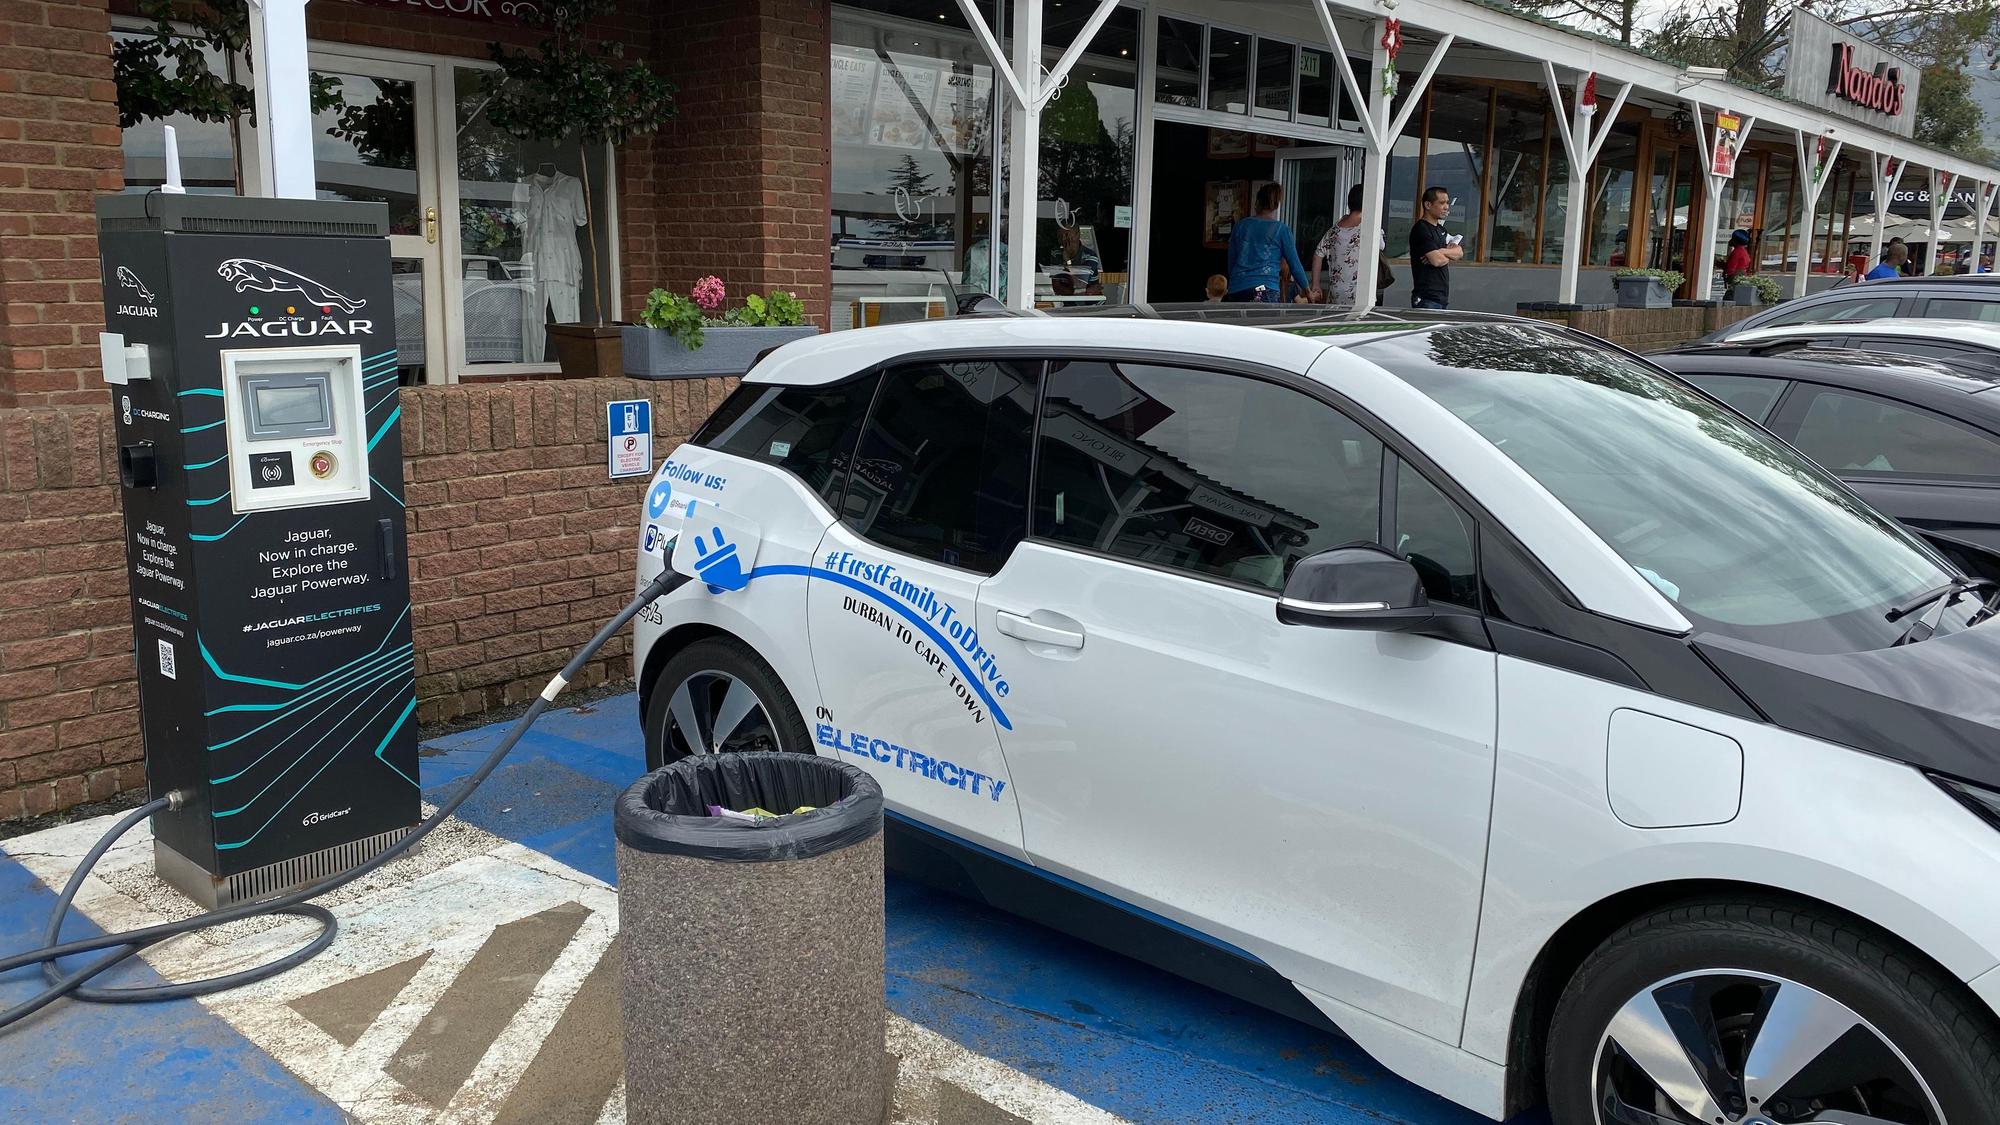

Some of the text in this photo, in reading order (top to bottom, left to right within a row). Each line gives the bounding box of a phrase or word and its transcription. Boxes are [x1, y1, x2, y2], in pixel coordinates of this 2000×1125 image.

[1835, 41, 1905, 116] Nando's
[1870, 191, 1914, 202] GG
[1918, 190, 1930, 202] &
[116, 304, 158, 318] JAGUAR
[204, 319, 374, 339] JAGUAR
[661, 460, 726, 491] Follow us:
[145, 520, 166, 537] Jaguar,
[284, 529, 332, 543] Jaguar,
[137, 533, 178, 555] Now in charge.
[259, 542, 358, 563] Now in charge.
[142, 550, 174, 570] Explore the
[272, 559, 348, 579] Explore the
[135, 563, 154, 579] Jaguar
[250, 573, 370, 599] Jaguar Powerway.
[242, 603, 382, 633] #JAGUARELECTRIFIES
[824, 551, 1011, 698] #FirstFamilyToDrive
[266, 624, 362, 648] jaguar.co.za/powerway
[843, 595, 985, 724] DURBAN TO CAPE TOWN
[816, 706, 834, 722] ON
[816, 722, 1006, 802] ELECTRICITY
